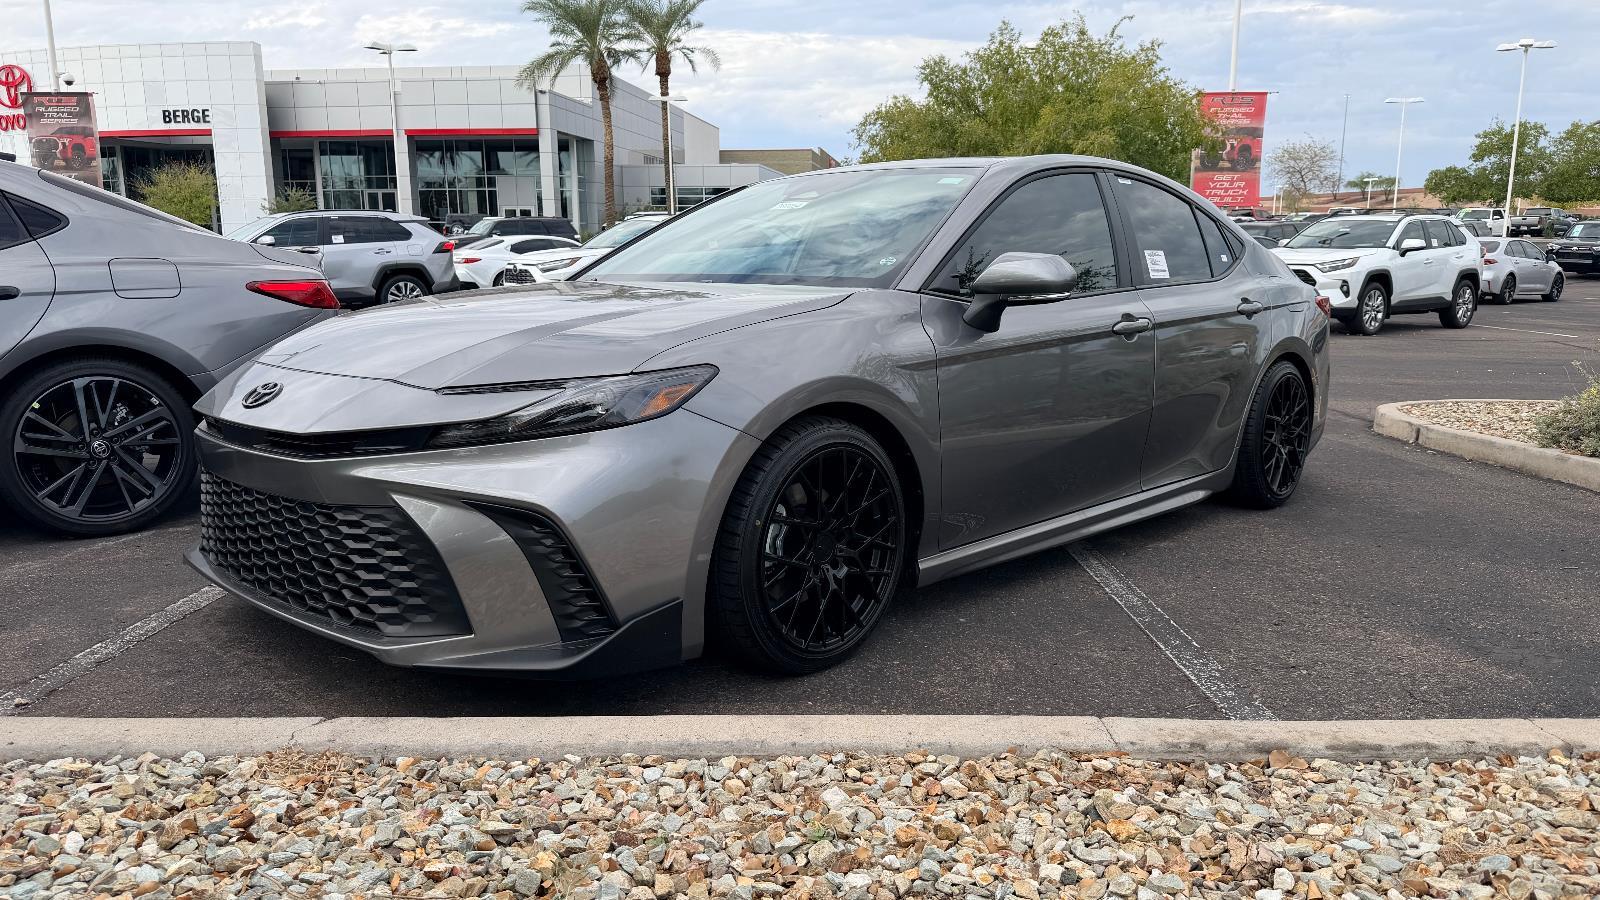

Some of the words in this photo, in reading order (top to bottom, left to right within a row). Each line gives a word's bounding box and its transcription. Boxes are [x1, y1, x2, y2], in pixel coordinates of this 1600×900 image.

[1211, 96, 1255, 105] RTS
[0, 114, 26, 131] OYO
[163, 109, 210, 124] BERGE
